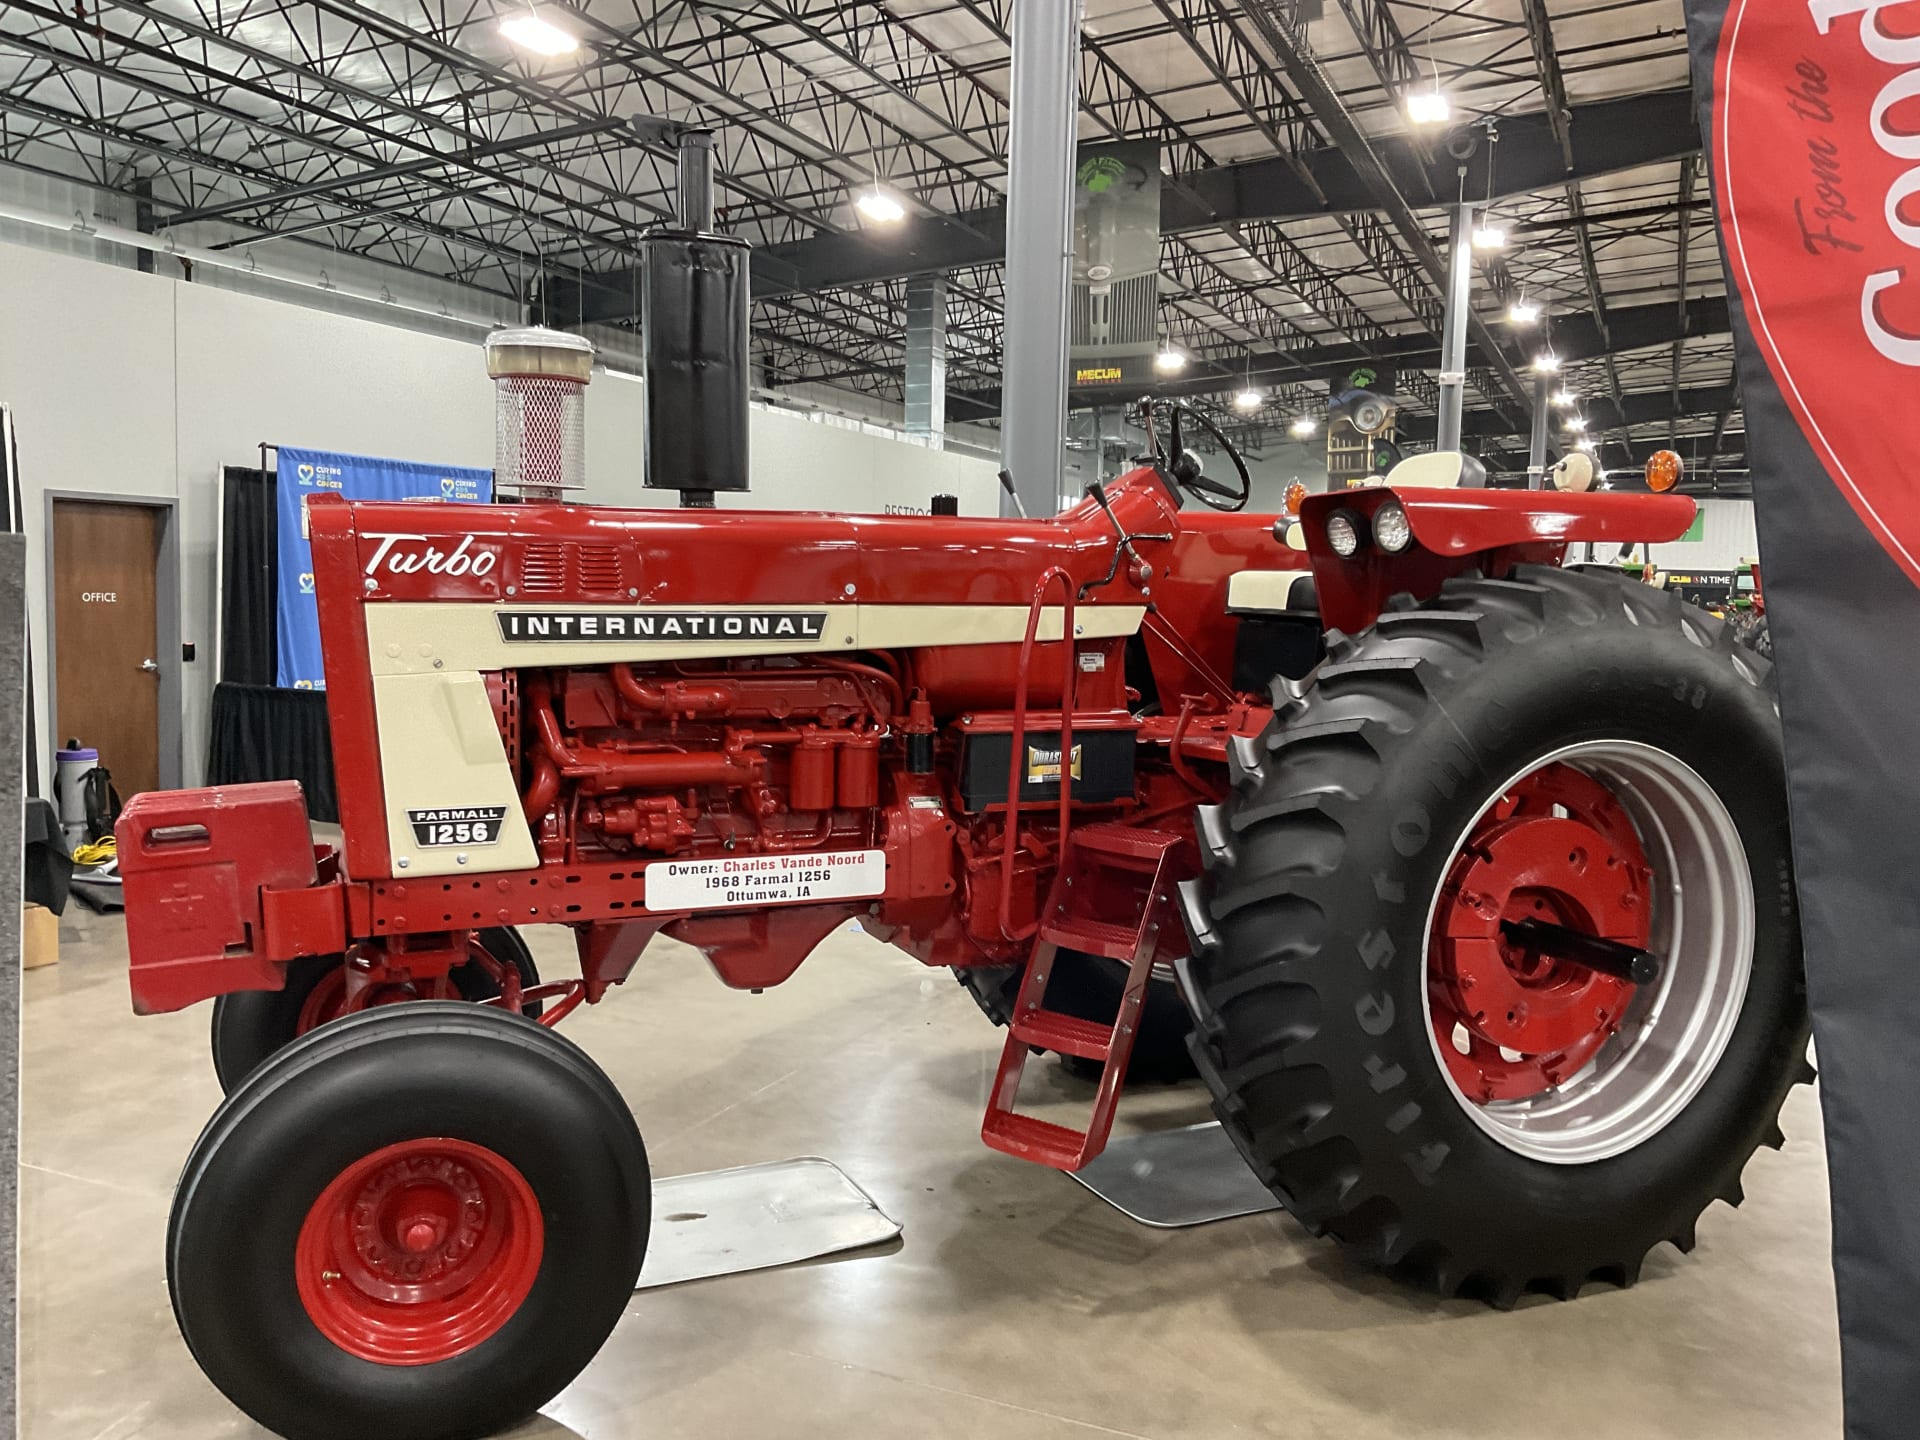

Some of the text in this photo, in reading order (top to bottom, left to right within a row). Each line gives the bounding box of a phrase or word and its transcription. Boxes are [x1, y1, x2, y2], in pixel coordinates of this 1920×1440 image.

[1785, 56, 1864, 256] From the
[1076, 367, 1122, 380] MECUM
[359, 531, 497, 577] Turbo
[1708, 575, 1731, 585] TIME
[82, 592, 117, 602] OFFICE
[510, 616, 818, 635] INTERNATIONAL
[416, 809, 498, 821] FARMALL
[429, 822, 488, 844] 1256
[668, 853, 865, 876] Owner: Charles Vande Noord
[705, 870, 831, 889] 1968 Farmal 1256
[727, 886, 811, 902] Ottumwa, IA
